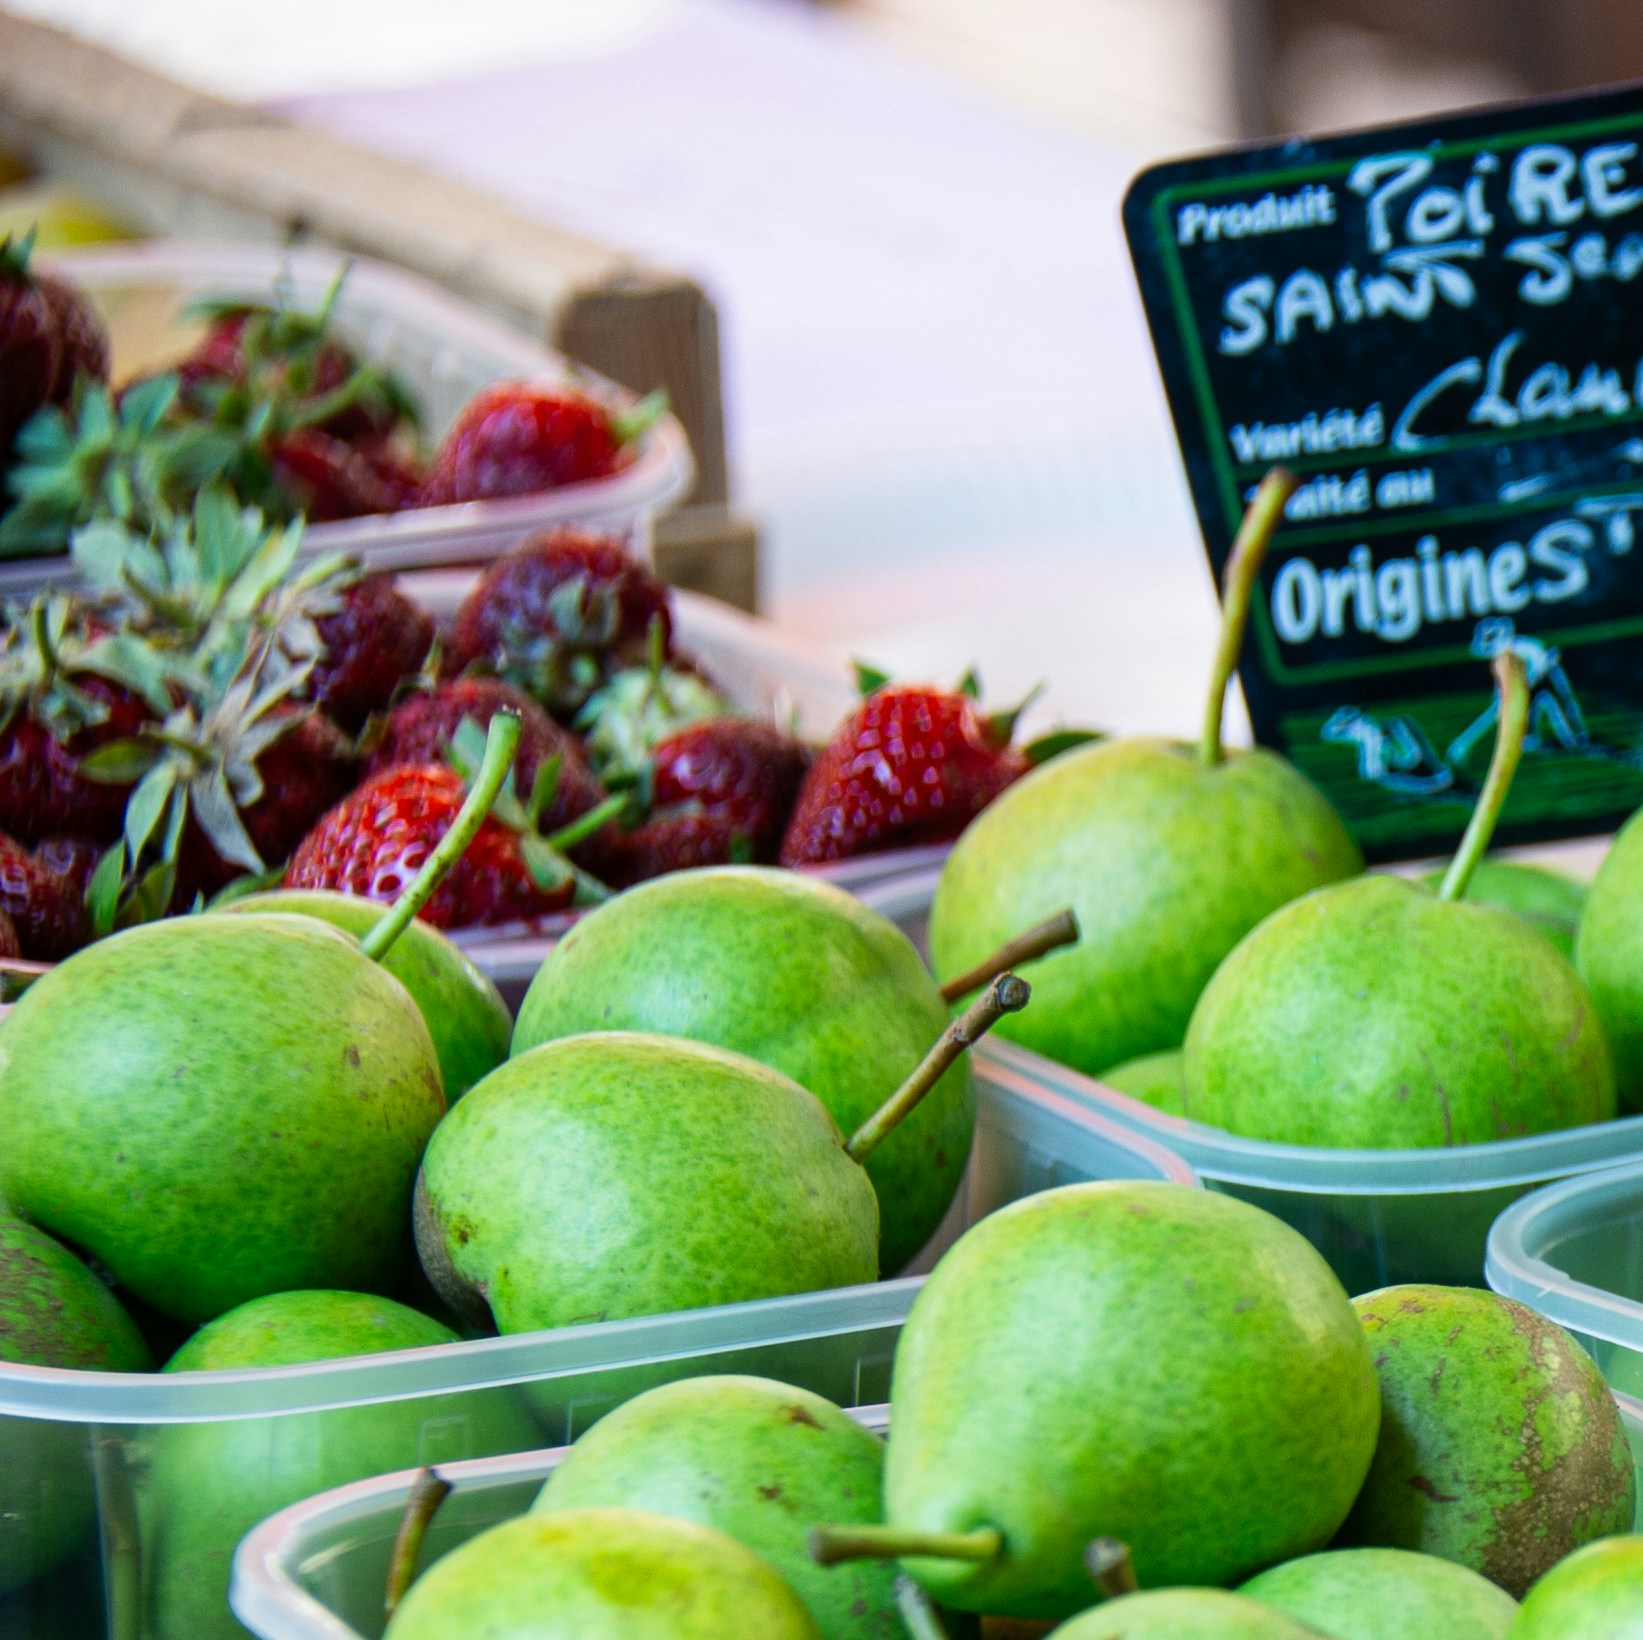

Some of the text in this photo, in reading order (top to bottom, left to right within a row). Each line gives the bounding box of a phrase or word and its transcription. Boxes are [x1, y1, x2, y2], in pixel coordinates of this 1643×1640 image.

[1176, 183, 1336, 246] Produit
[1229, 402, 1388, 465] Variété
[1244, 466, 1436, 521] aité au
[1271, 533, 1530, 645] Origine
